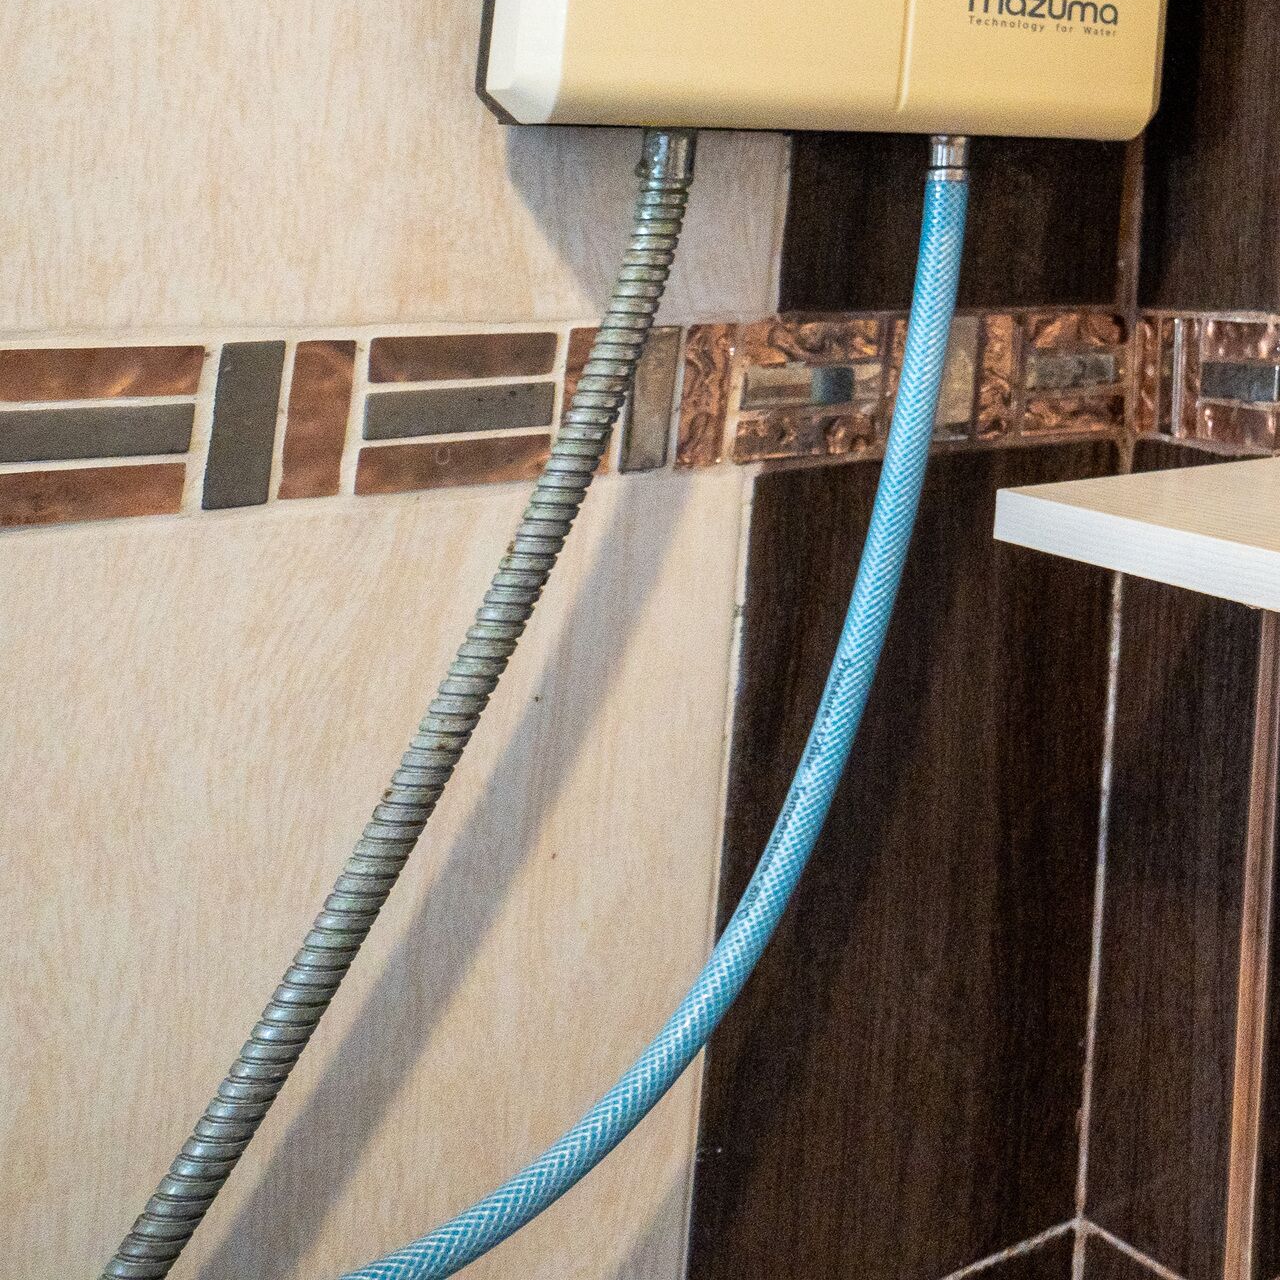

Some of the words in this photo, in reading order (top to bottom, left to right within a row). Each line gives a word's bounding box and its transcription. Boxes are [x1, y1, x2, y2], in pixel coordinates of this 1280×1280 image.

[969, 15, 1045, 32] Technology
[1056, 23, 1073, 33] for
[1083, 26, 1117, 37] Water
